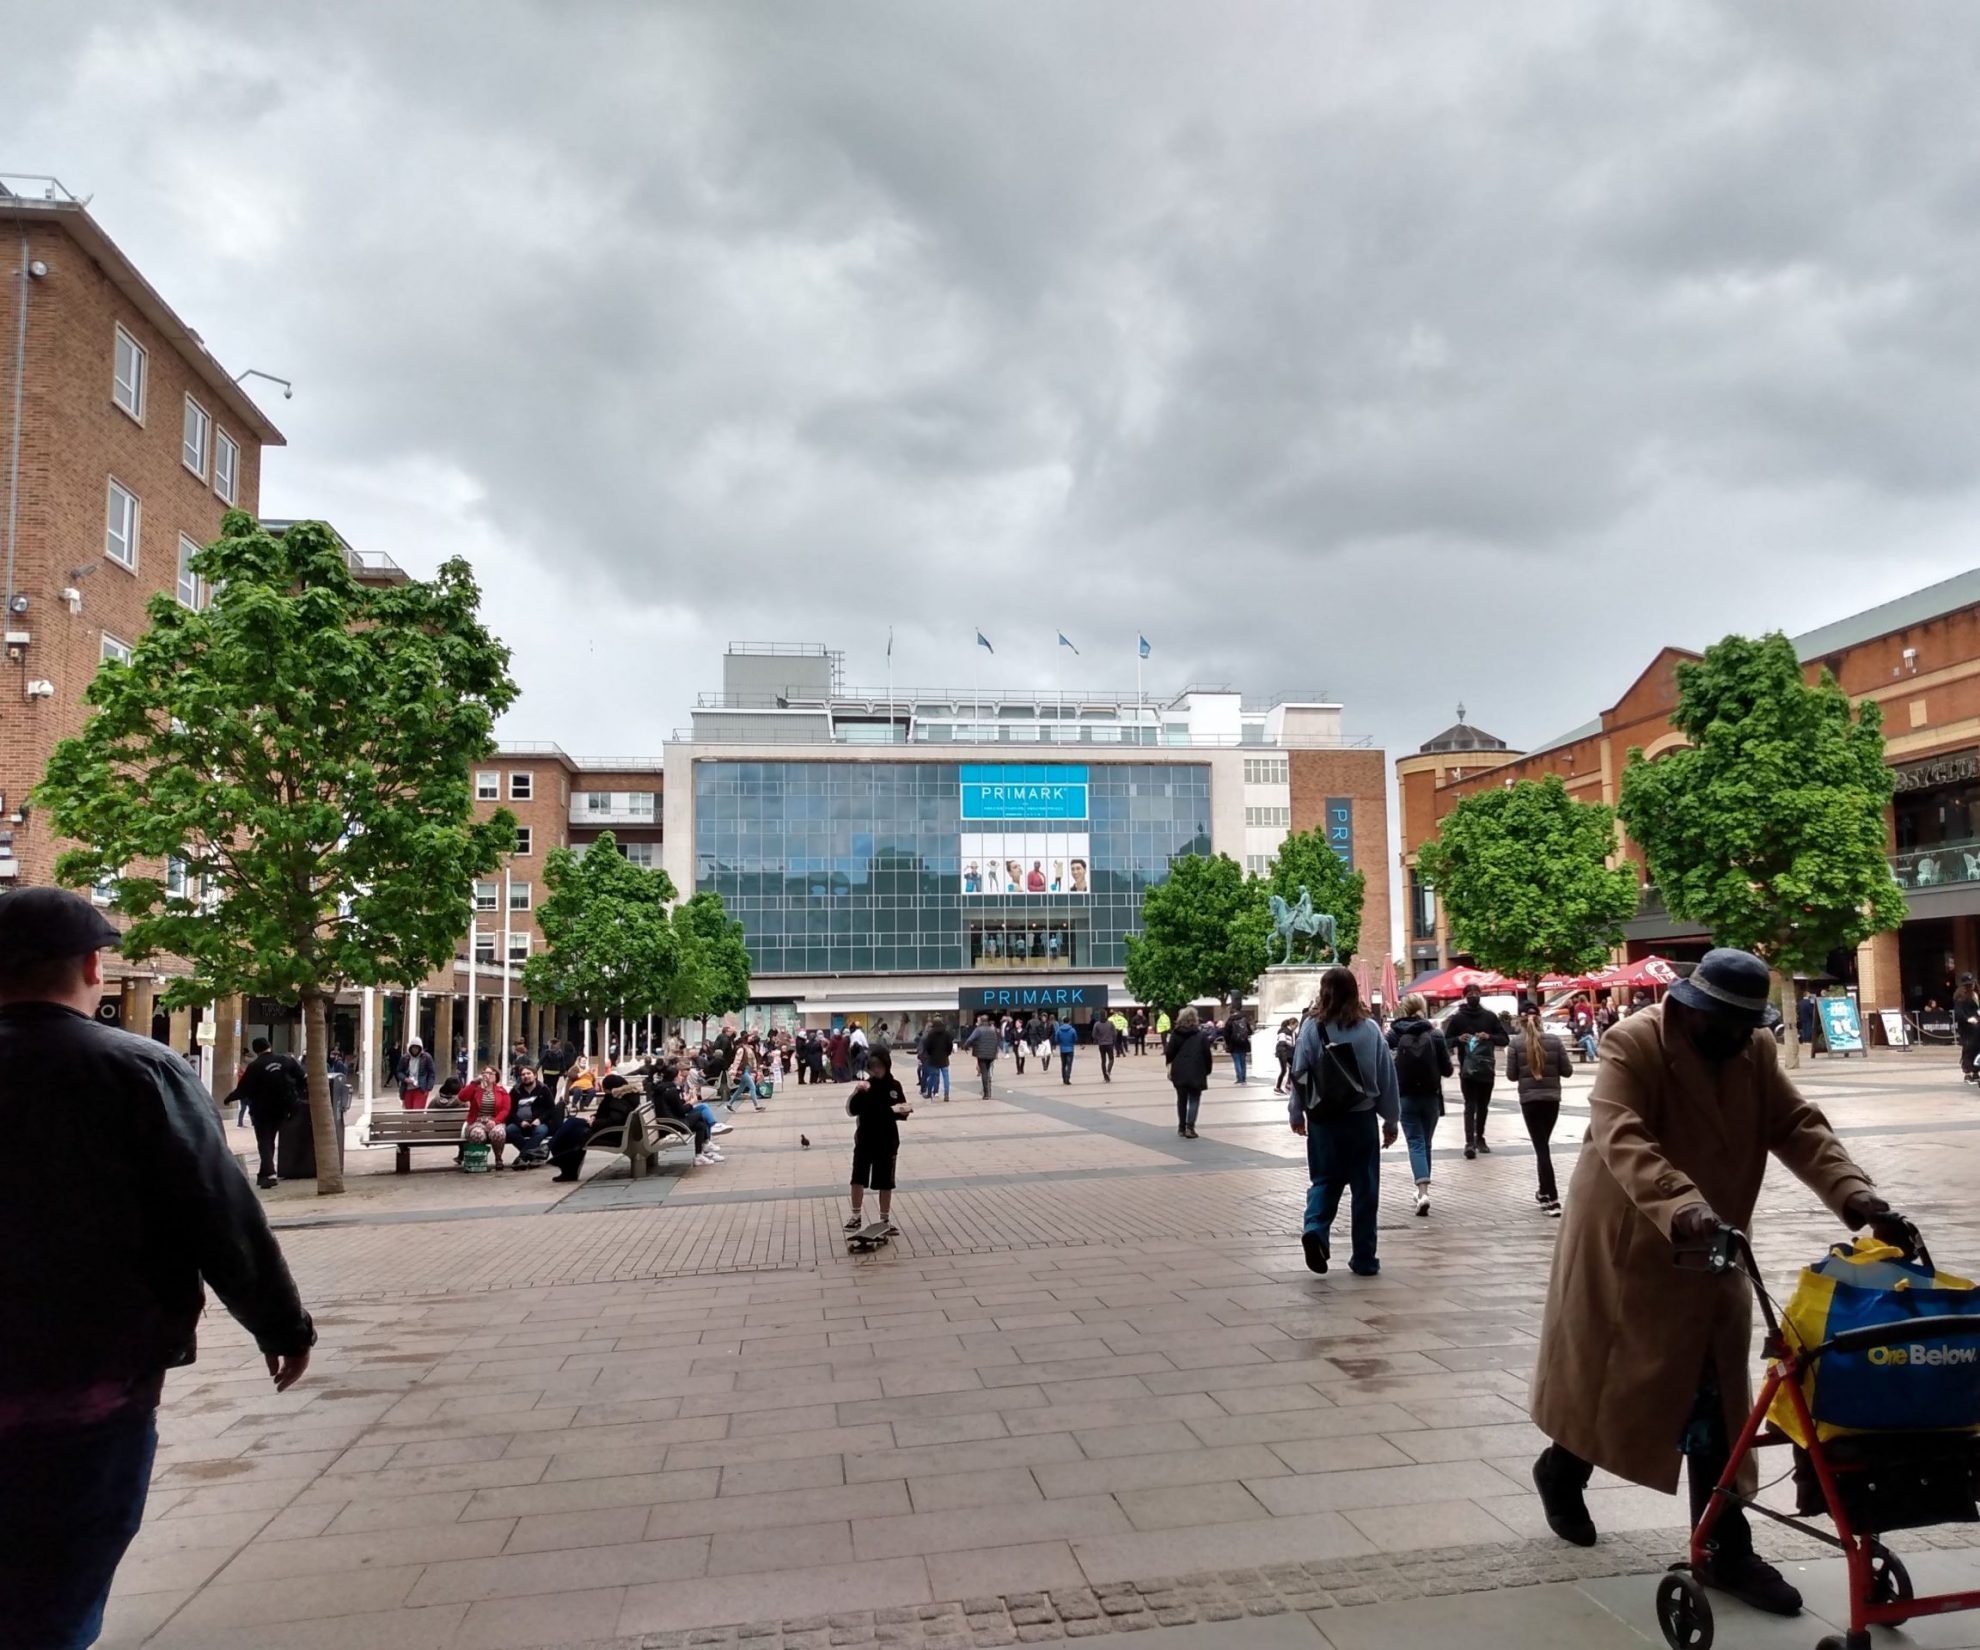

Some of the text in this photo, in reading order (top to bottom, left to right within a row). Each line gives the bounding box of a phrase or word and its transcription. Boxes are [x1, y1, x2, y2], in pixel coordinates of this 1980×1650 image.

[1893, 766, 1930, 793] OSY
[981, 787, 1064, 800] PRIMARK
[984, 989, 1084, 1005] PRIMARK
